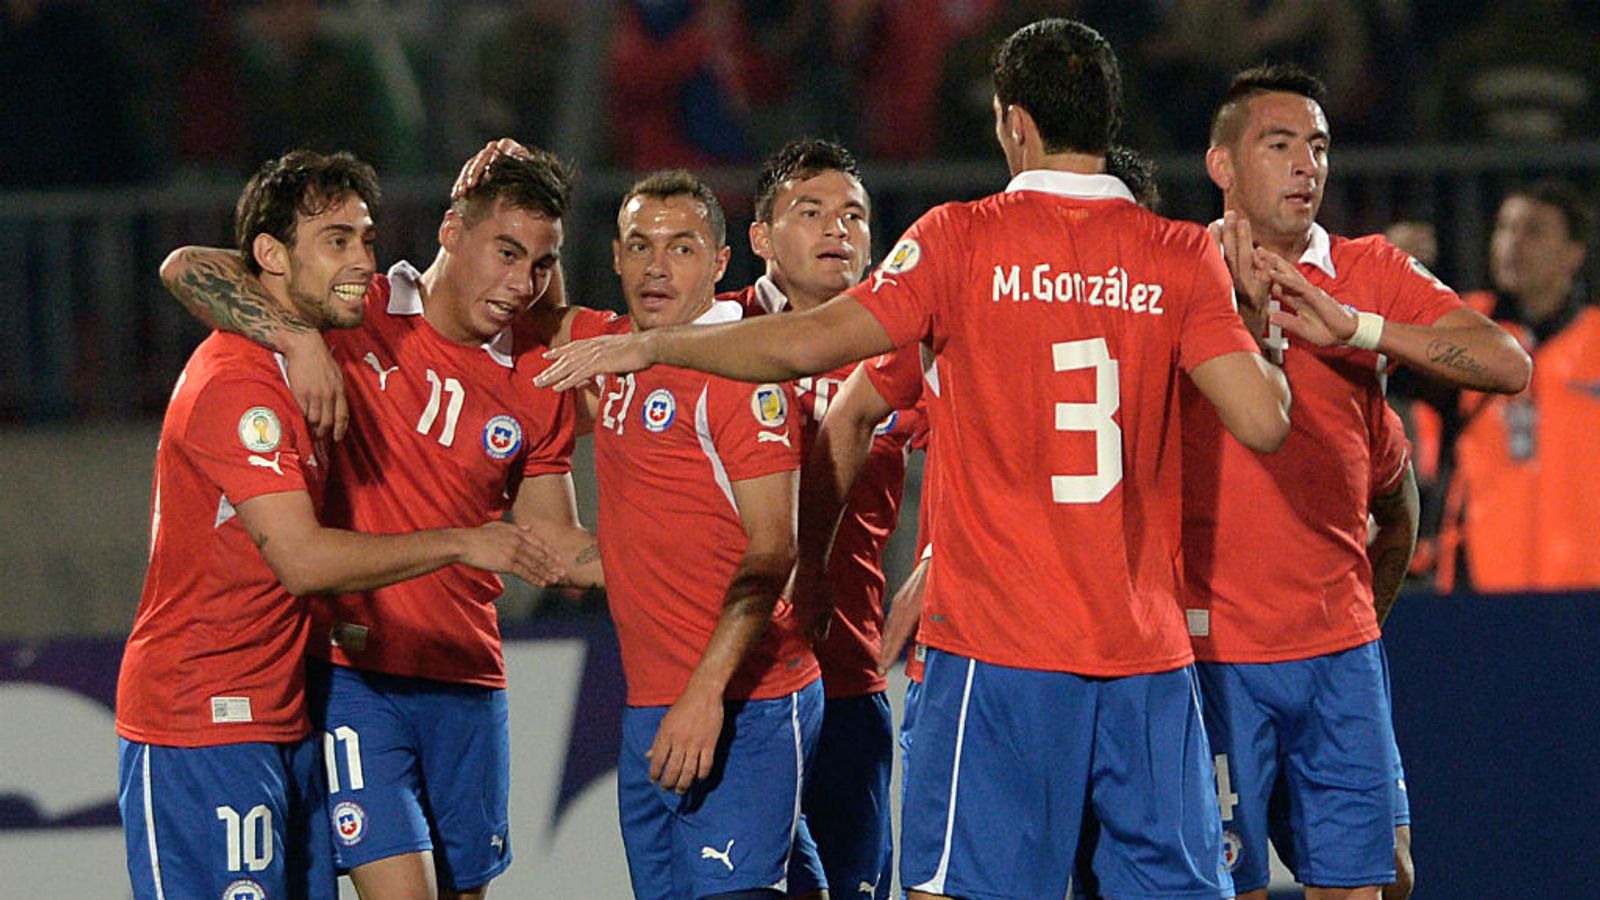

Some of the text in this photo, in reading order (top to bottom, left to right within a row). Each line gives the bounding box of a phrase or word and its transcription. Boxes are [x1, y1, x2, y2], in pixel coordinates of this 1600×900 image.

[416, 368, 465, 448] 11
[602, 372, 636, 436] 21
[1051, 337, 1124, 504] 3
[323, 725, 364, 794] 11
[216, 804, 273, 872] 10
